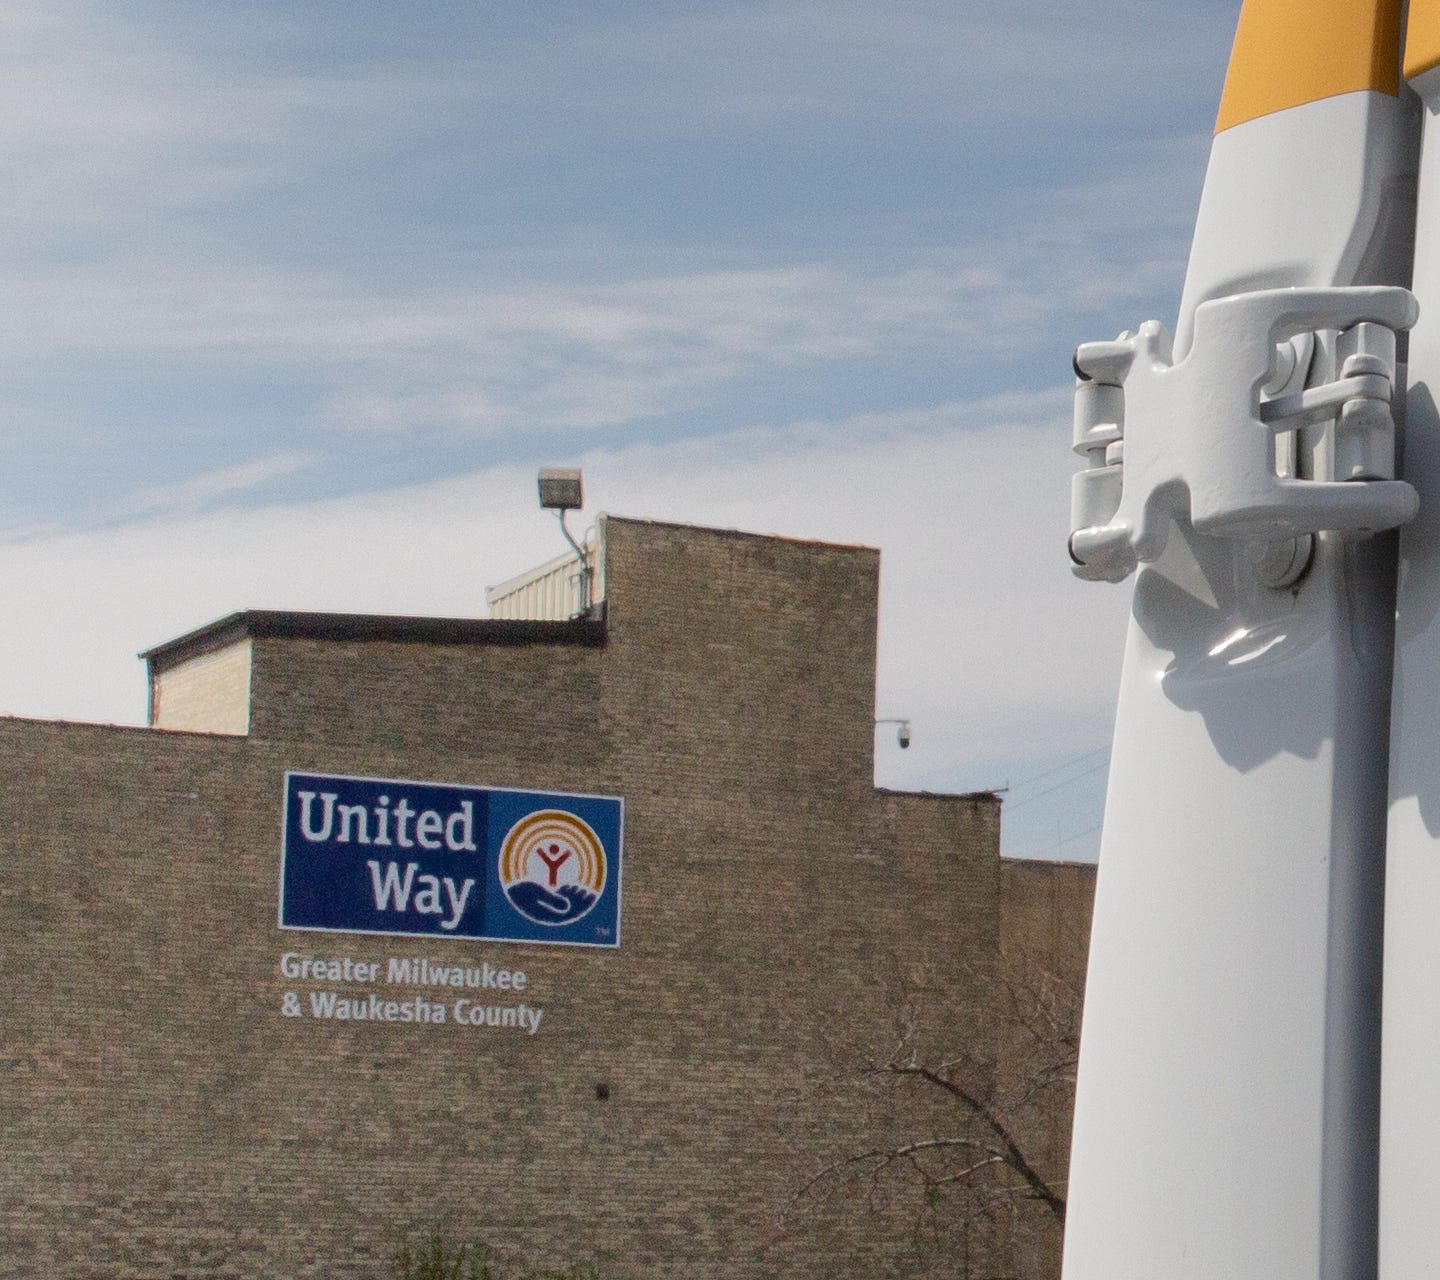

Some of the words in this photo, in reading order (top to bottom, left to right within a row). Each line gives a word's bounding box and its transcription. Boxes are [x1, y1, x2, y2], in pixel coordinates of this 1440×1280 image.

[298, 791, 477, 852] United
[367, 860, 476, 930] Way
[280, 951, 381, 983] Greater
[386, 958, 528, 991] Milwaukee
[280, 991, 303, 1018] &
[310, 992, 447, 1025] Waukesha
[453, 998, 544, 1035] County
